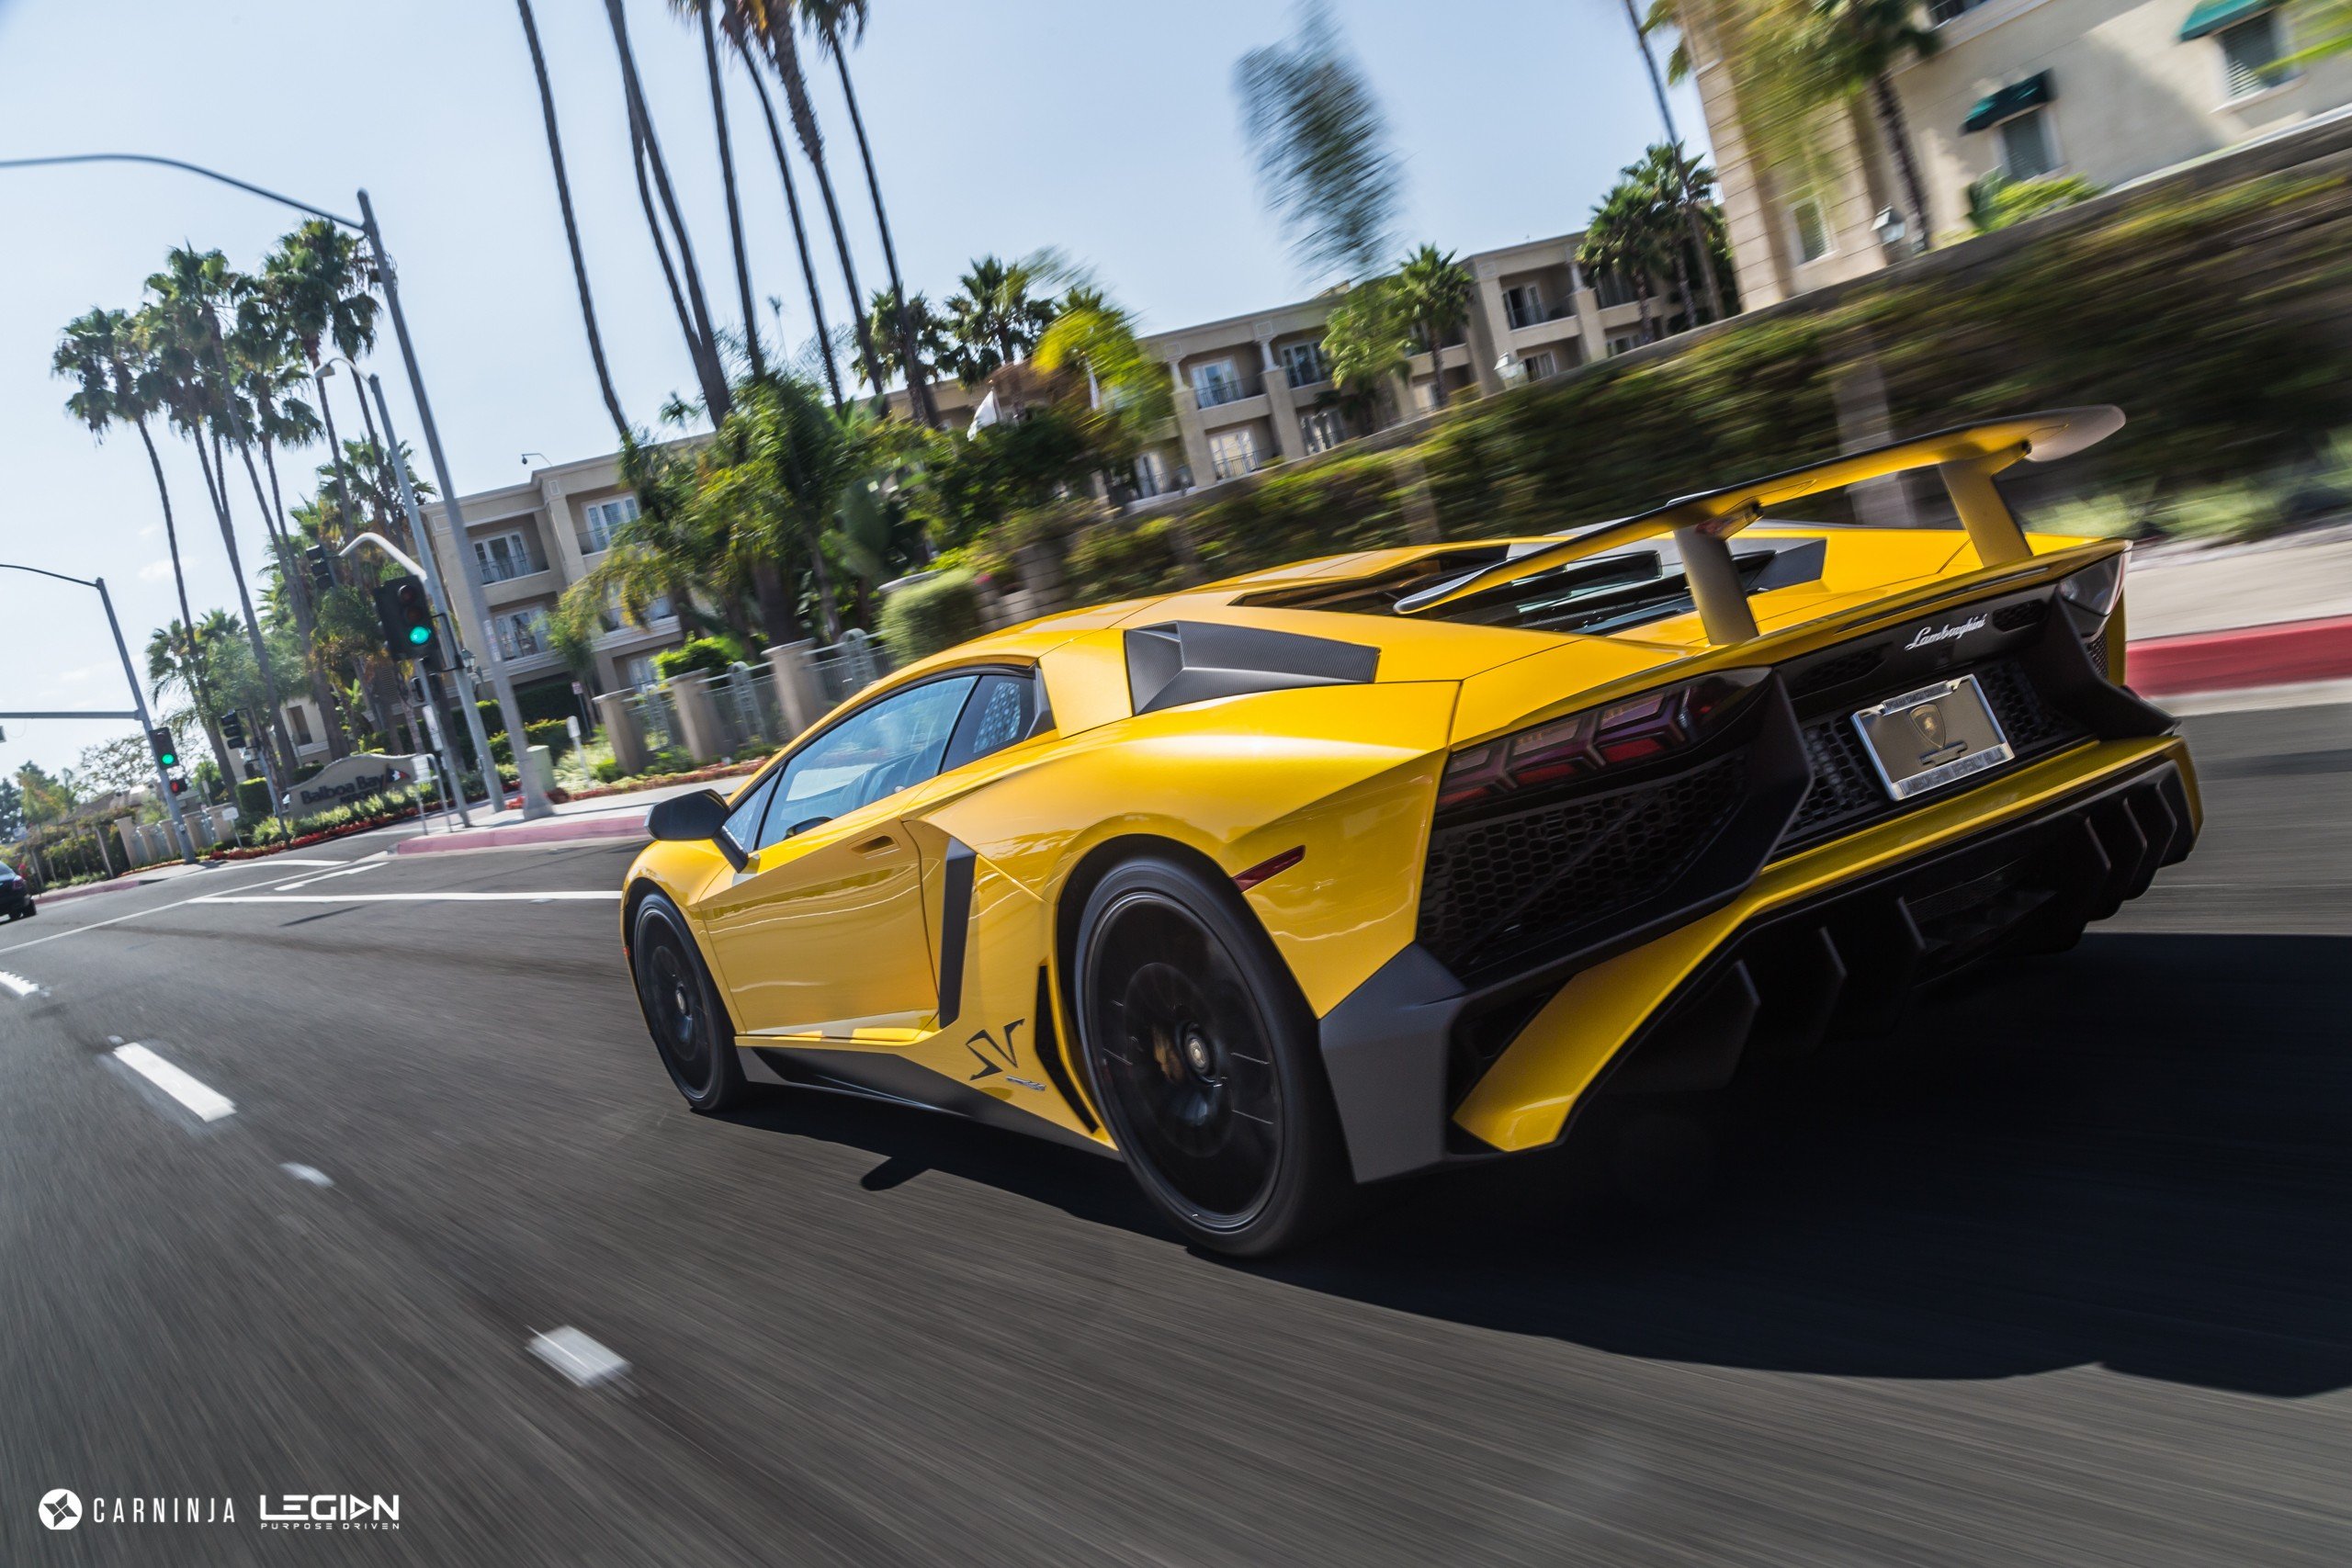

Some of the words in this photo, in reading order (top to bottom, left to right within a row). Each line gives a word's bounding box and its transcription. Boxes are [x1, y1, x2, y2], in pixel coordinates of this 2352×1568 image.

[1904, 613, 1987, 650] Lamborghini
[300, 782, 356, 805] Balboa
[356, 775, 384, 795] Bay
